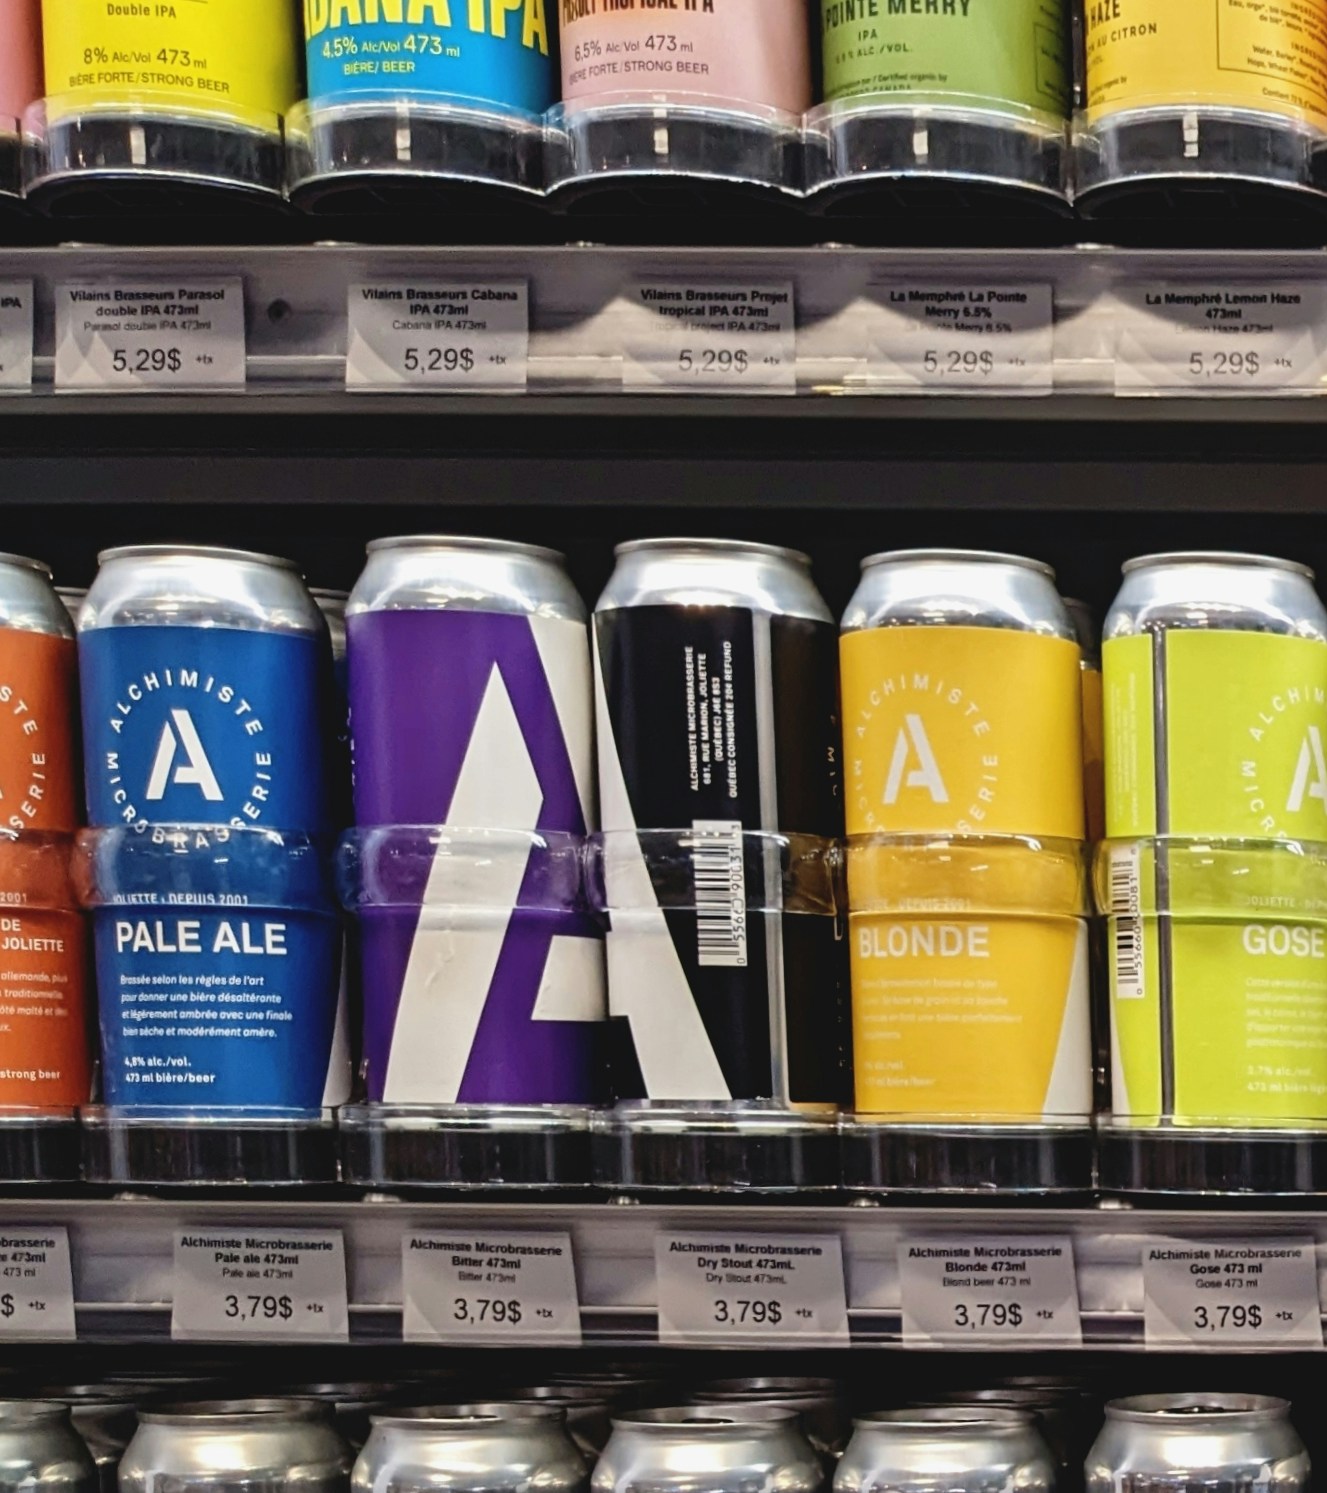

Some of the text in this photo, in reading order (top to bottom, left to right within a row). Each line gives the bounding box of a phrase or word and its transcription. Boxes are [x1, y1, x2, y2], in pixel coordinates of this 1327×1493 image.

[107, 4, 176, 18] Double IPA
[404, 35, 442, 55] 473
[83, 47, 190, 66] 8% Alc/Vol 473
[383, 61, 415, 73] BEER
[198, 78, 229, 92] BEER
[70, 289, 112, 301] Vilains
[116, 289, 174, 301] Brasseurs
[112, 347, 181, 374] 5,29$
[110, 668, 262, 737] ALCHIMISTE
[1, 937, 64, 953] JOLIETTE
[116, 921, 288, 955] PALE ALE
[859, 926, 990, 960] BLONDE
[1243, 924, 1325, 958] GOSE
[180, 1237, 333, 1251] Alchimiste Microbrasserie
[214, 1252, 298, 1265] Pale 473ml
[945, 1261, 987, 1273] Blonde
[225, 1296, 293, 1320] 3,79$
[453, 1298, 521, 1323] 3,79$
[1194, 1305, 1262, 1330] 3,79$
